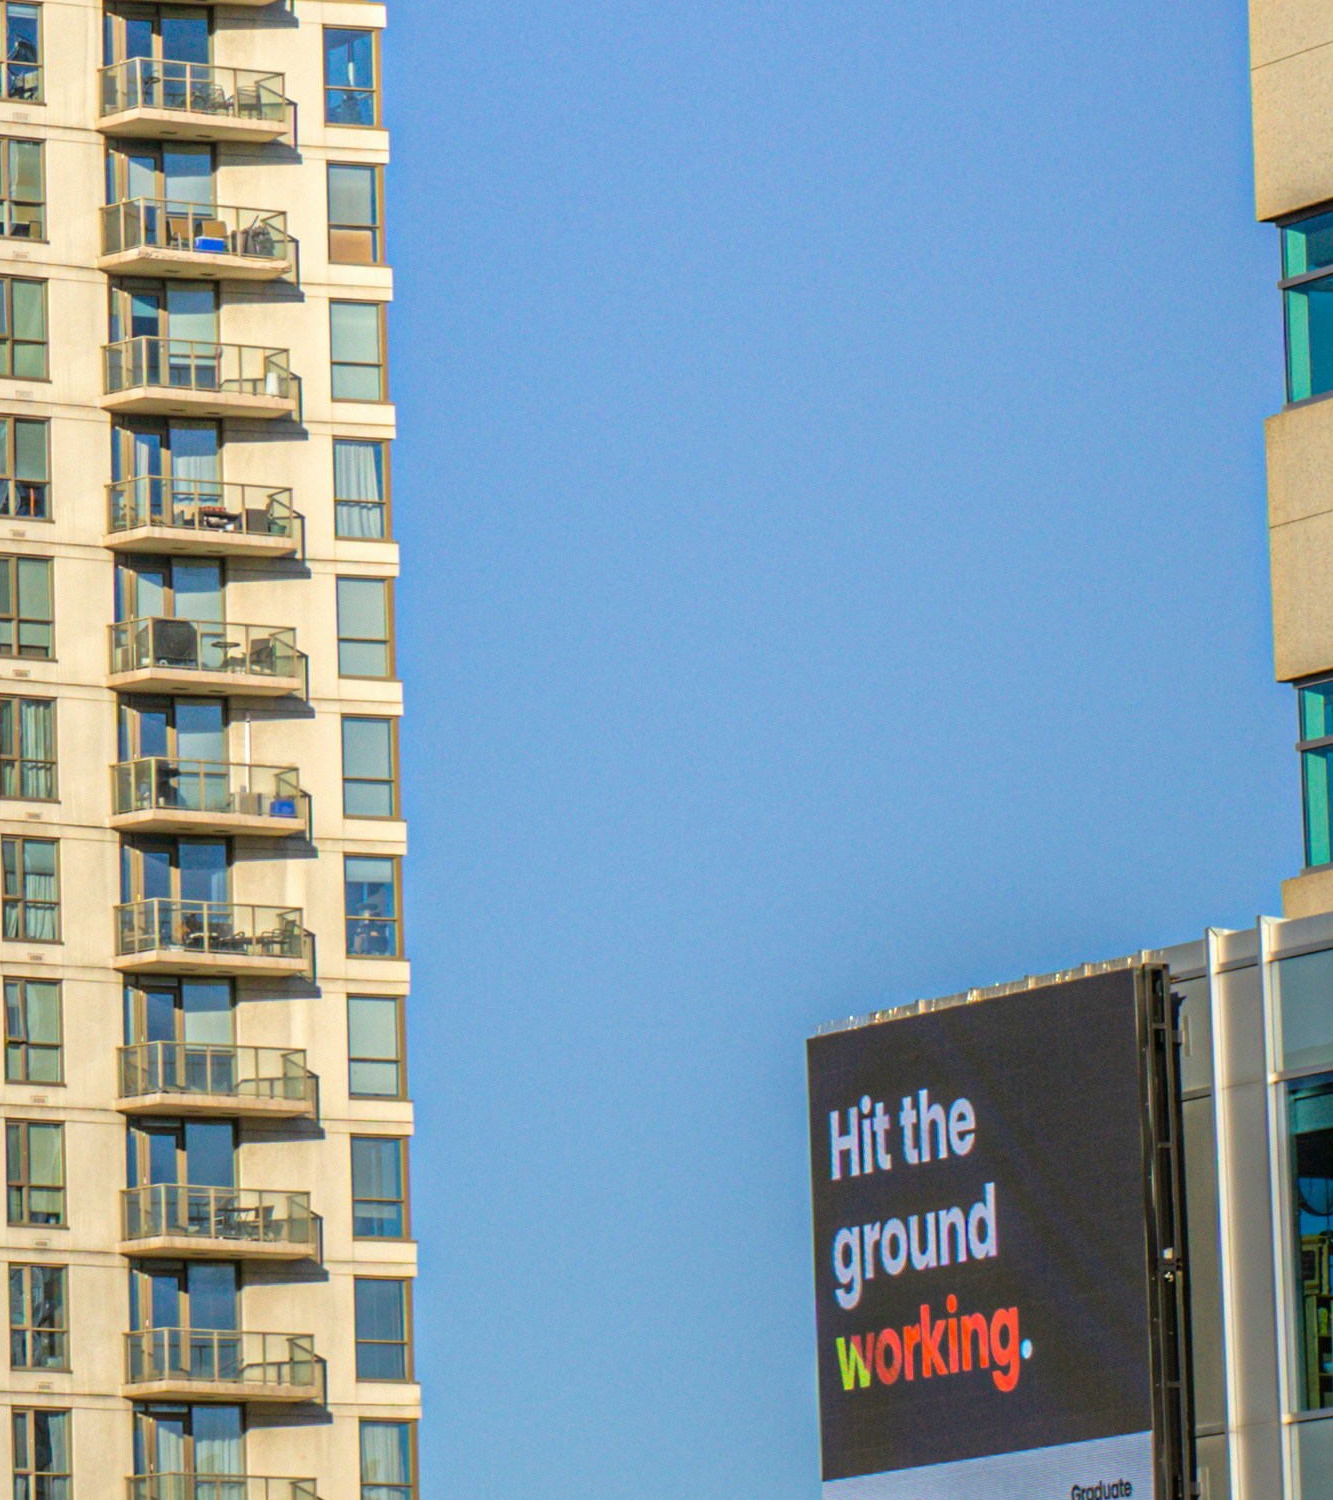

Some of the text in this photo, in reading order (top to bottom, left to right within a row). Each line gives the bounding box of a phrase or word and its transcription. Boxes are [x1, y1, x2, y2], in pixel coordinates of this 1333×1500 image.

[829, 1087, 976, 1181] Hit the
[833, 1181, 998, 1311] ground
[835, 1293, 1033, 1393] working.
